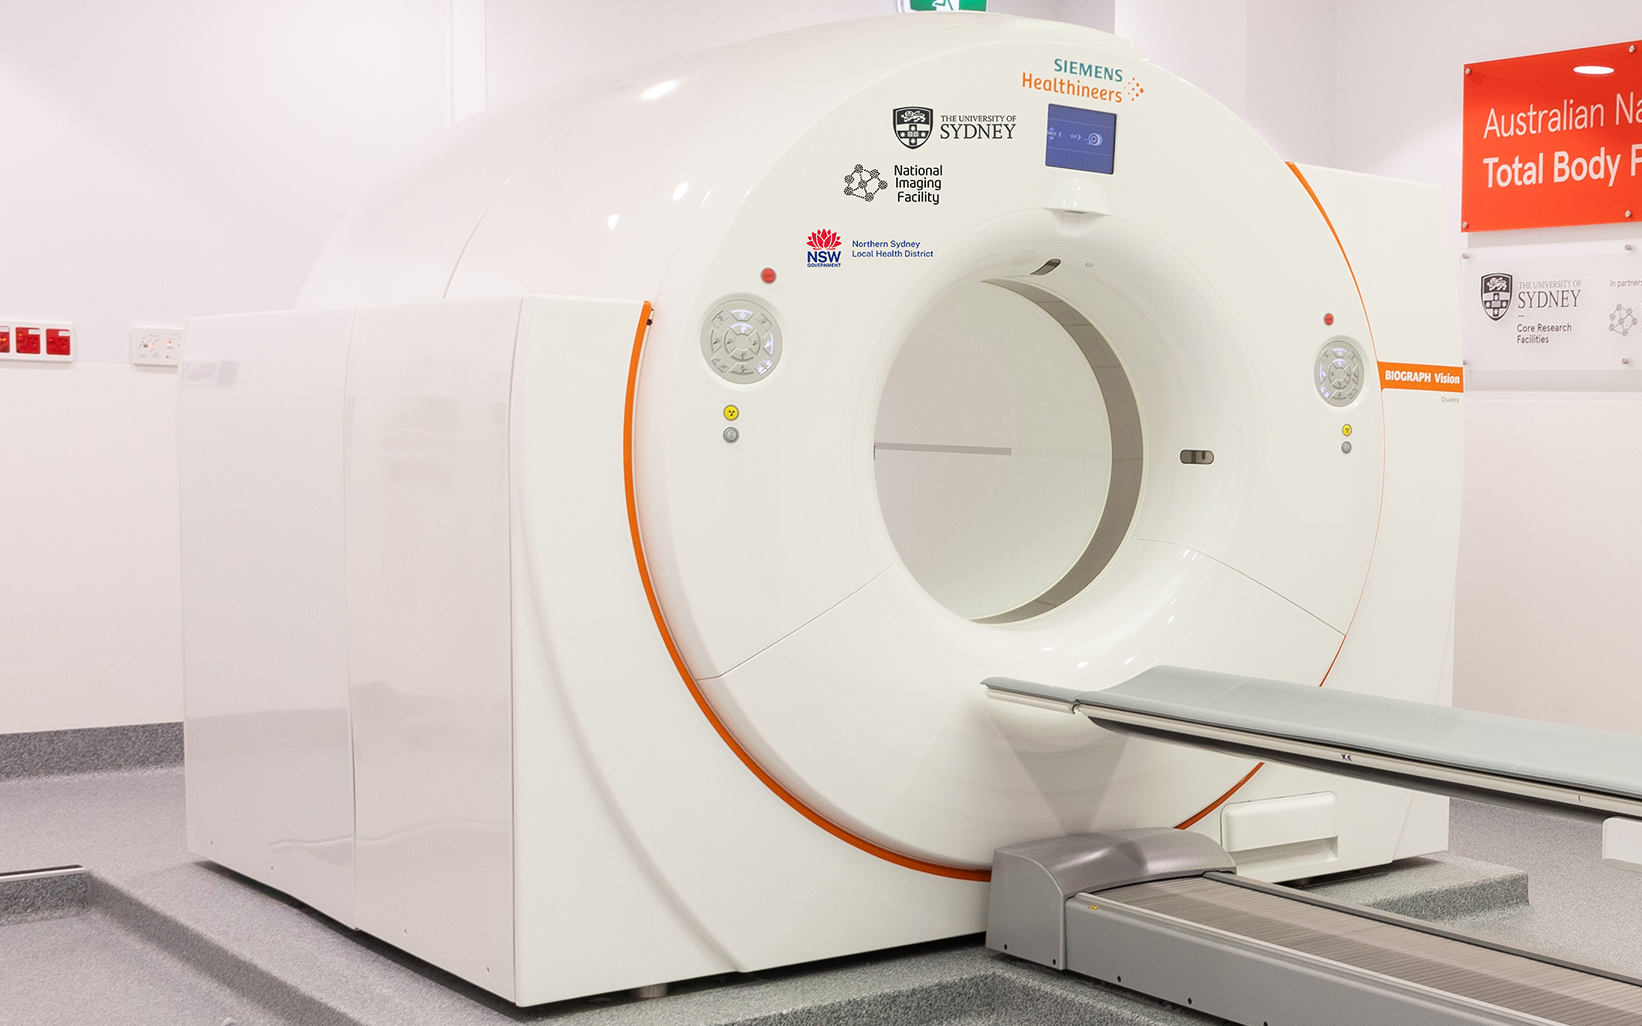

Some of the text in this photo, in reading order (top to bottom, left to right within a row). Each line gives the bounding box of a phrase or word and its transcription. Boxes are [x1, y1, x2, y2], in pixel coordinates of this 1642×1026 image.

[1054, 58, 1123, 82] SIEMENS
[1022, 72, 1122, 103] Healthineers
[1483, 99, 1604, 139] Australian
[940, 123, 1016, 139] SYDNEY
[894, 165, 943, 176] National
[1483, 152, 1544, 188] Total
[1553, 147, 1622, 187] Body
[895, 177, 942, 191] Imaging
[897, 191, 940, 205] Facility
[852, 240, 921, 250] Northern Sydney
[807, 251, 842, 263] NSW
[852, 250, 934, 258] Local Health District
[1519, 279, 1582, 289] THE UNIVERSITY OF
[1518, 289, 1582, 309] SYDNEY
[1517, 322, 1572, 333] Core Research
[1517, 334, 1549, 344] Facilities
[1385, 370, 1461, 385] BIOGRAPH Vision
[1441, 395, 1460, 404] Quadra
